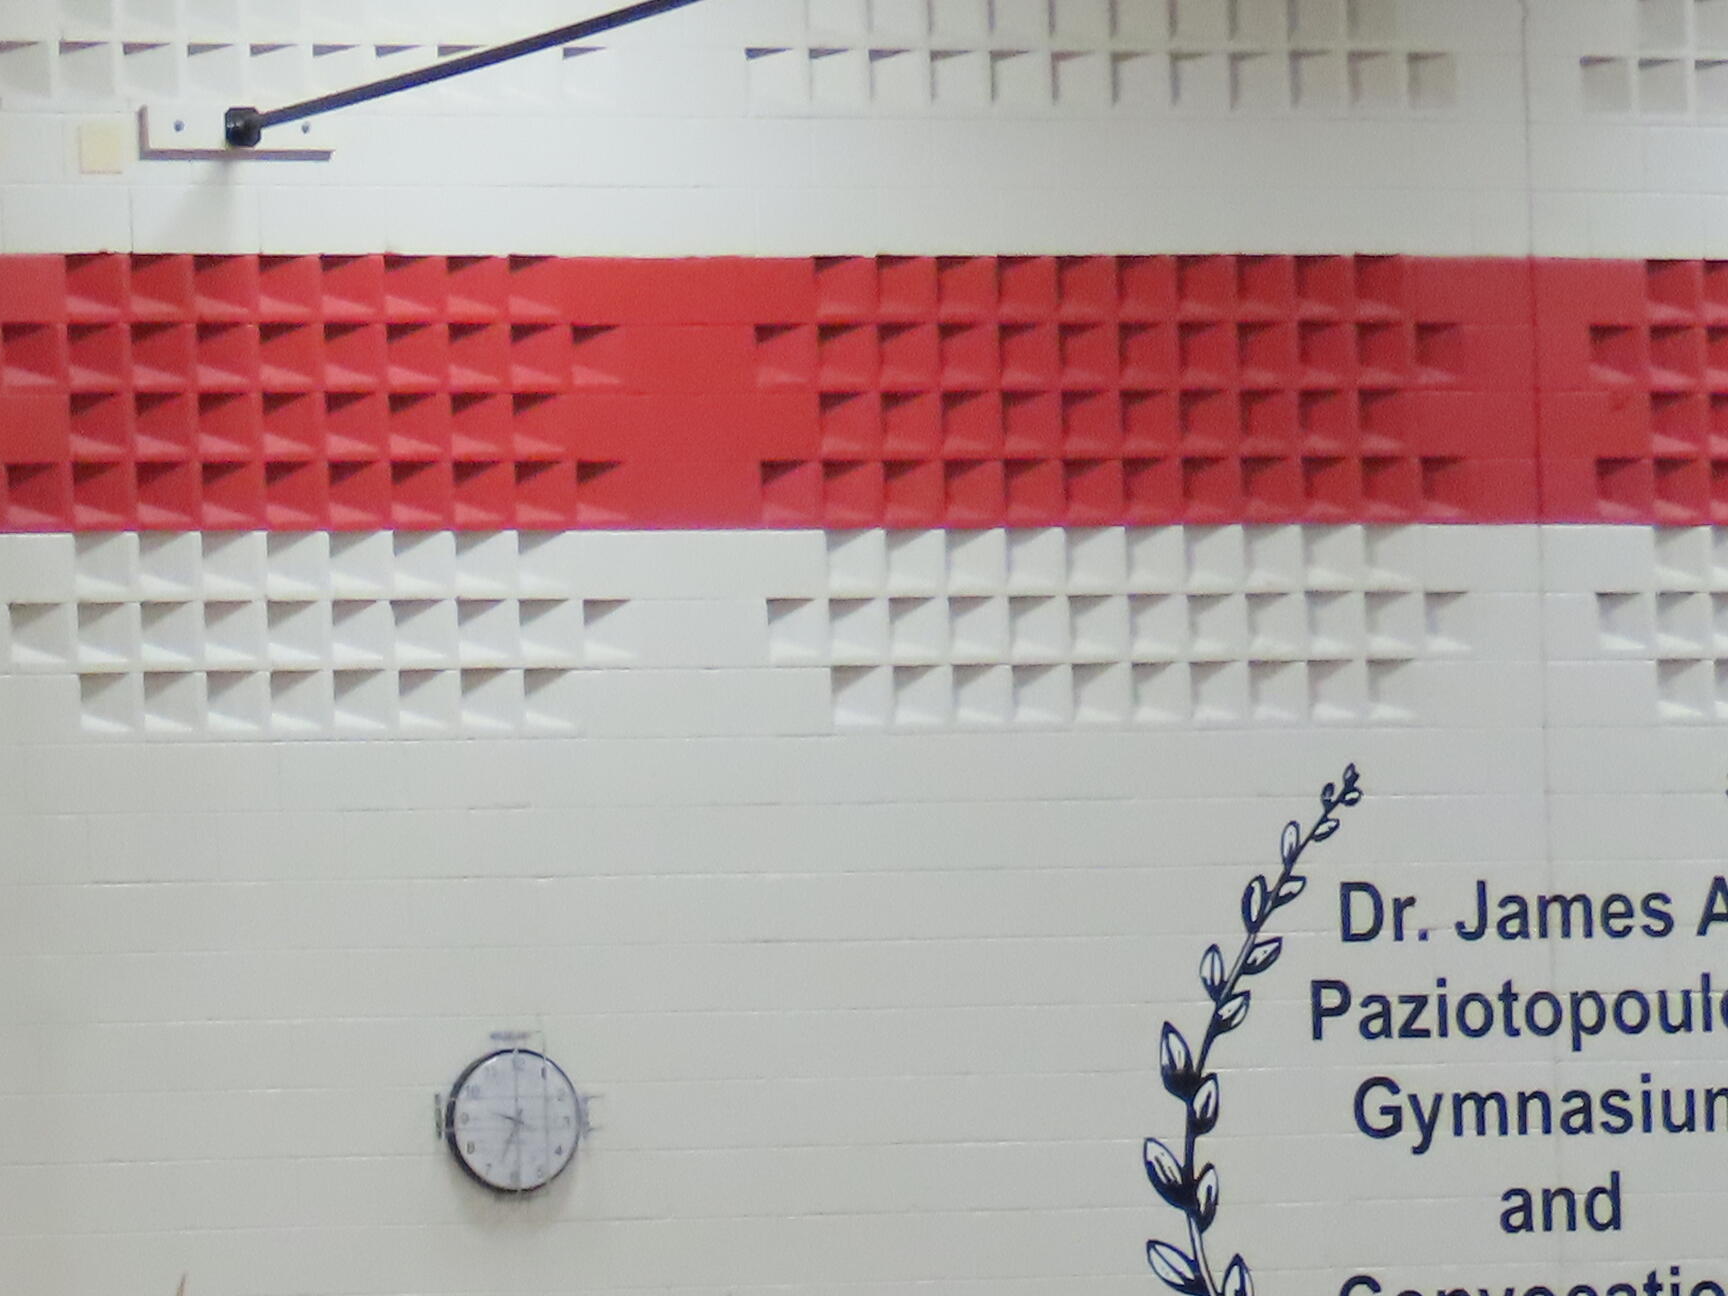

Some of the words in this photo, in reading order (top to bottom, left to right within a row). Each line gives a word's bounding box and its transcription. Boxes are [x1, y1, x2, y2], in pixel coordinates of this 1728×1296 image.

[1340, 880, 1431, 943] Dr.
[1455, 879, 1675, 942] James
[1310, 973, 1728, 1052] Paziotopoul
[1499, 1171, 1623, 1235] and
